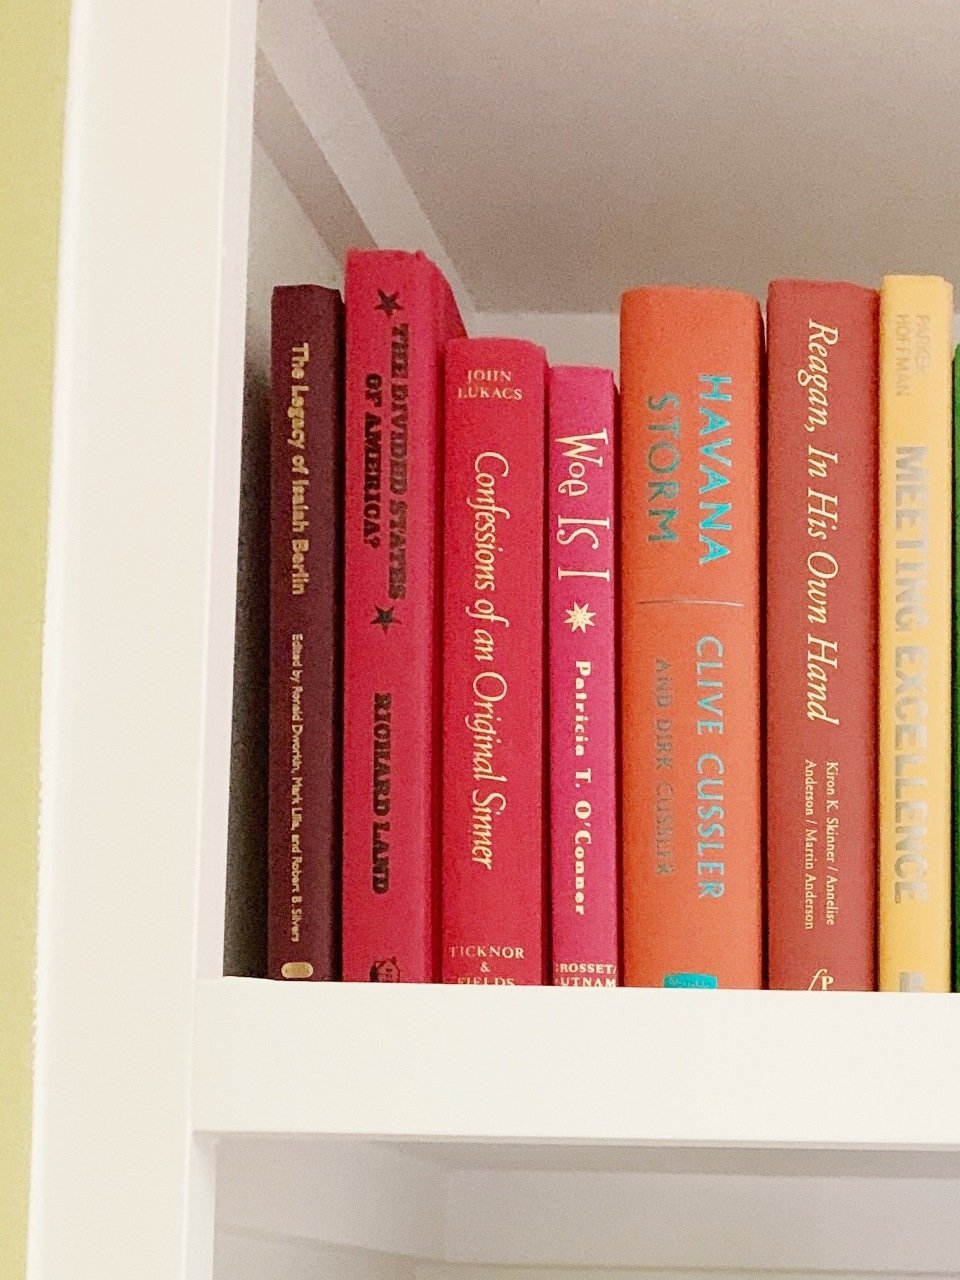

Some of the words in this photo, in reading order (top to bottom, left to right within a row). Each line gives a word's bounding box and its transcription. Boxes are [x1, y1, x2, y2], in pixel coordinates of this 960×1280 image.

[292, 343, 309, 379] The
[391, 324, 409, 378] THE
[467, 369, 512, 383] JOHN
[798, 320, 838, 432] Reagan,
[365, 374, 382, 407] OF
[458, 388, 523, 400] LUKACS
[287, 386, 309, 448] Legacy
[390, 383, 408, 495] DIVIDED
[292, 455, 309, 474] of
[364, 412, 381, 548] AMERICA?
[555, 429, 609, 496] Woe
[648, 392, 681, 542] STORM
[699, 375, 732, 564] HAVANA
[808, 445, 838, 477] In
[292, 480, 309, 532] Isaiah
[468, 452, 510, 590] Confessions
[808, 488, 838, 540] His
[389, 500, 407, 599] STATES
[556, 515, 610, 549] Is
[895, 446, 929, 631] MEETING
[292, 539, 309, 594] Berlin
[558, 566, 610, 581] I
[808, 552, 838, 623] Own
[466, 599, 509, 626] of
[292, 634, 303, 667] Edited
[474, 629, 494, 661] an
[290, 670, 302, 682] by
[655, 658, 672, 709] AND
[696, 636, 724, 734] CLIVE
[807, 634, 839, 724] Hand
[292, 686, 303, 721] Ronald
[465, 672, 507, 782] Original
[575, 661, 591, 755] Patricia
[373, 693, 391, 816] RICHARD
[654, 719, 673, 769] DIRK
[292, 777, 302, 805] Mark
[576, 769, 591, 787] T.
[805, 760, 817, 815] Anderson
[827, 762, 838, 795] Kiron
[893, 645, 928, 904] EXCELLENCE
[472, 790, 506, 869] Sinner
[655, 782, 674, 876] CUSSLER
[697, 752, 725, 898] CUSSLER
[827, 800, 838, 812] K.
[292, 834, 301, 853] and
[372, 822, 389, 894] LAND
[575, 801, 591, 914] O'Conner
[805, 829, 817, 870] Martin
[826, 818, 839, 862] Skinner
[292, 857, 302, 893] Robert
[826, 876, 838, 925] Annelise
[291, 909, 302, 942] Silvers
[805, 873, 817, 929] Anderson
[449, 946, 525, 959] TICKNOR
[480, 961, 490, 973] &
[555, 976, 617, 987] UTNAM
